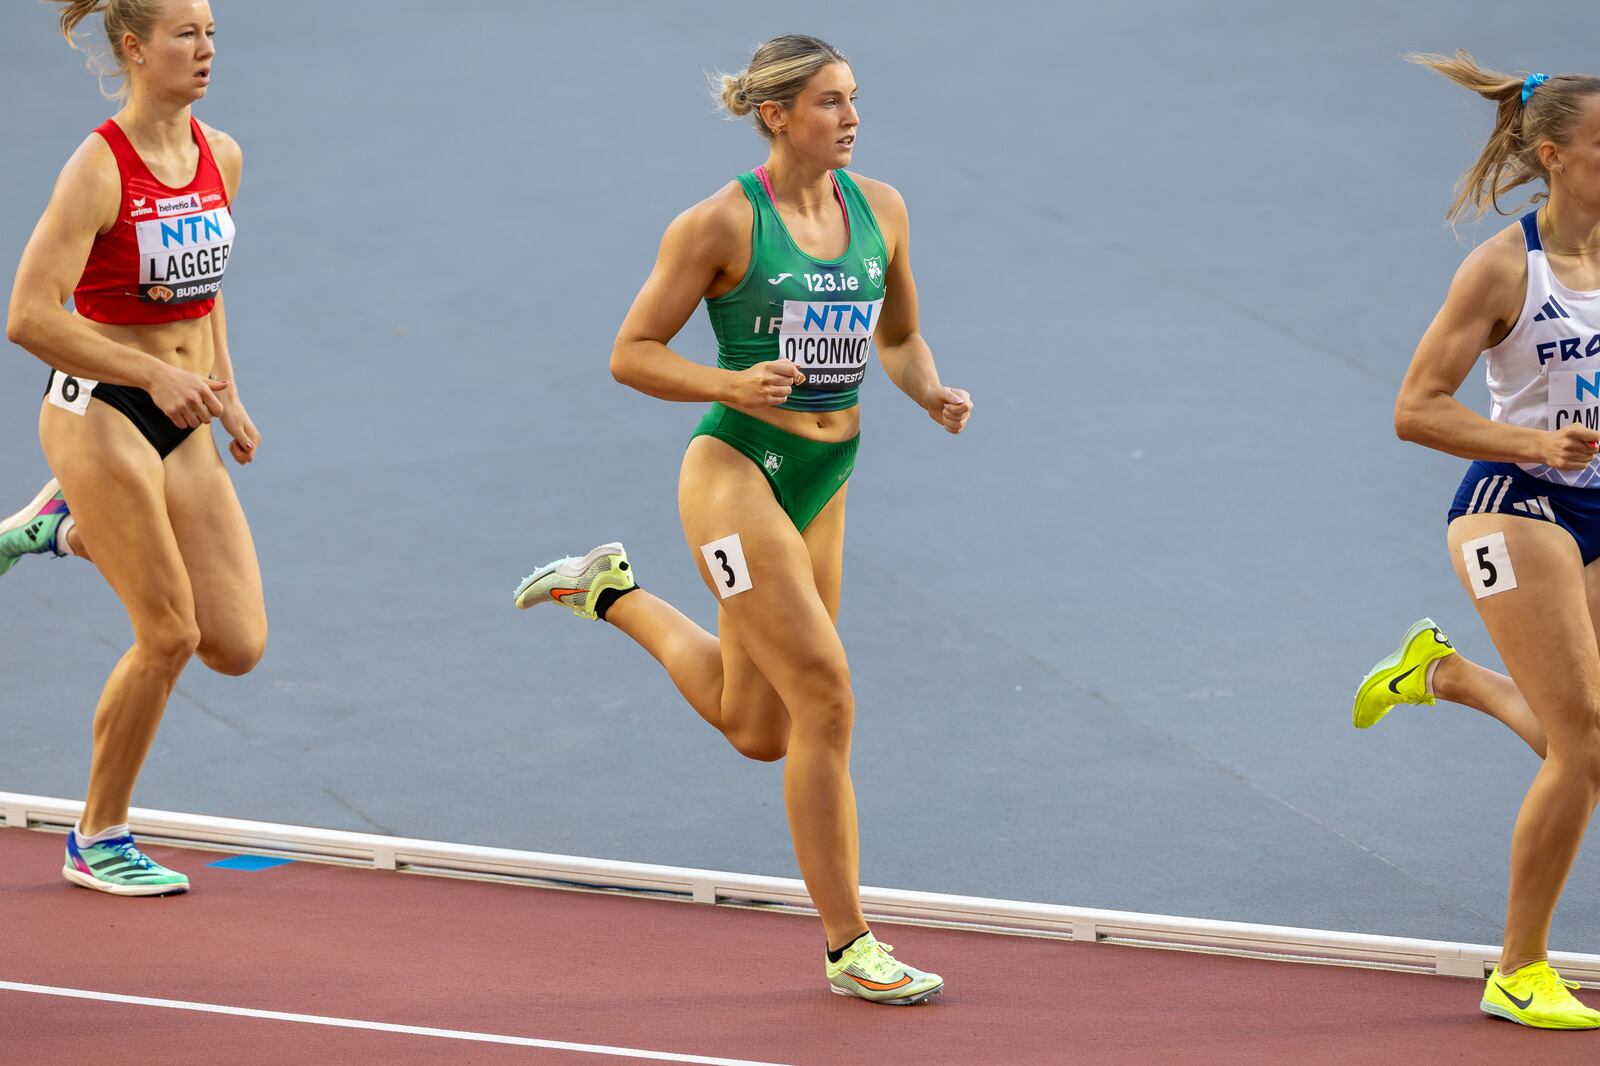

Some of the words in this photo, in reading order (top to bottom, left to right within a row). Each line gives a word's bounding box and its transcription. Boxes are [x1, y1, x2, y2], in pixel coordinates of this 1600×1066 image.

[159, 202, 189, 212] helvetia
[160, 212, 223, 249] NTN
[804, 273, 859, 292] 123.ie
[803, 304, 873, 333] NTN
[785, 335, 872, 365] O'CONNO
[62, 375, 80, 402] 6
[714, 549, 736, 588] 3
[1476, 546, 1498, 588] 5
